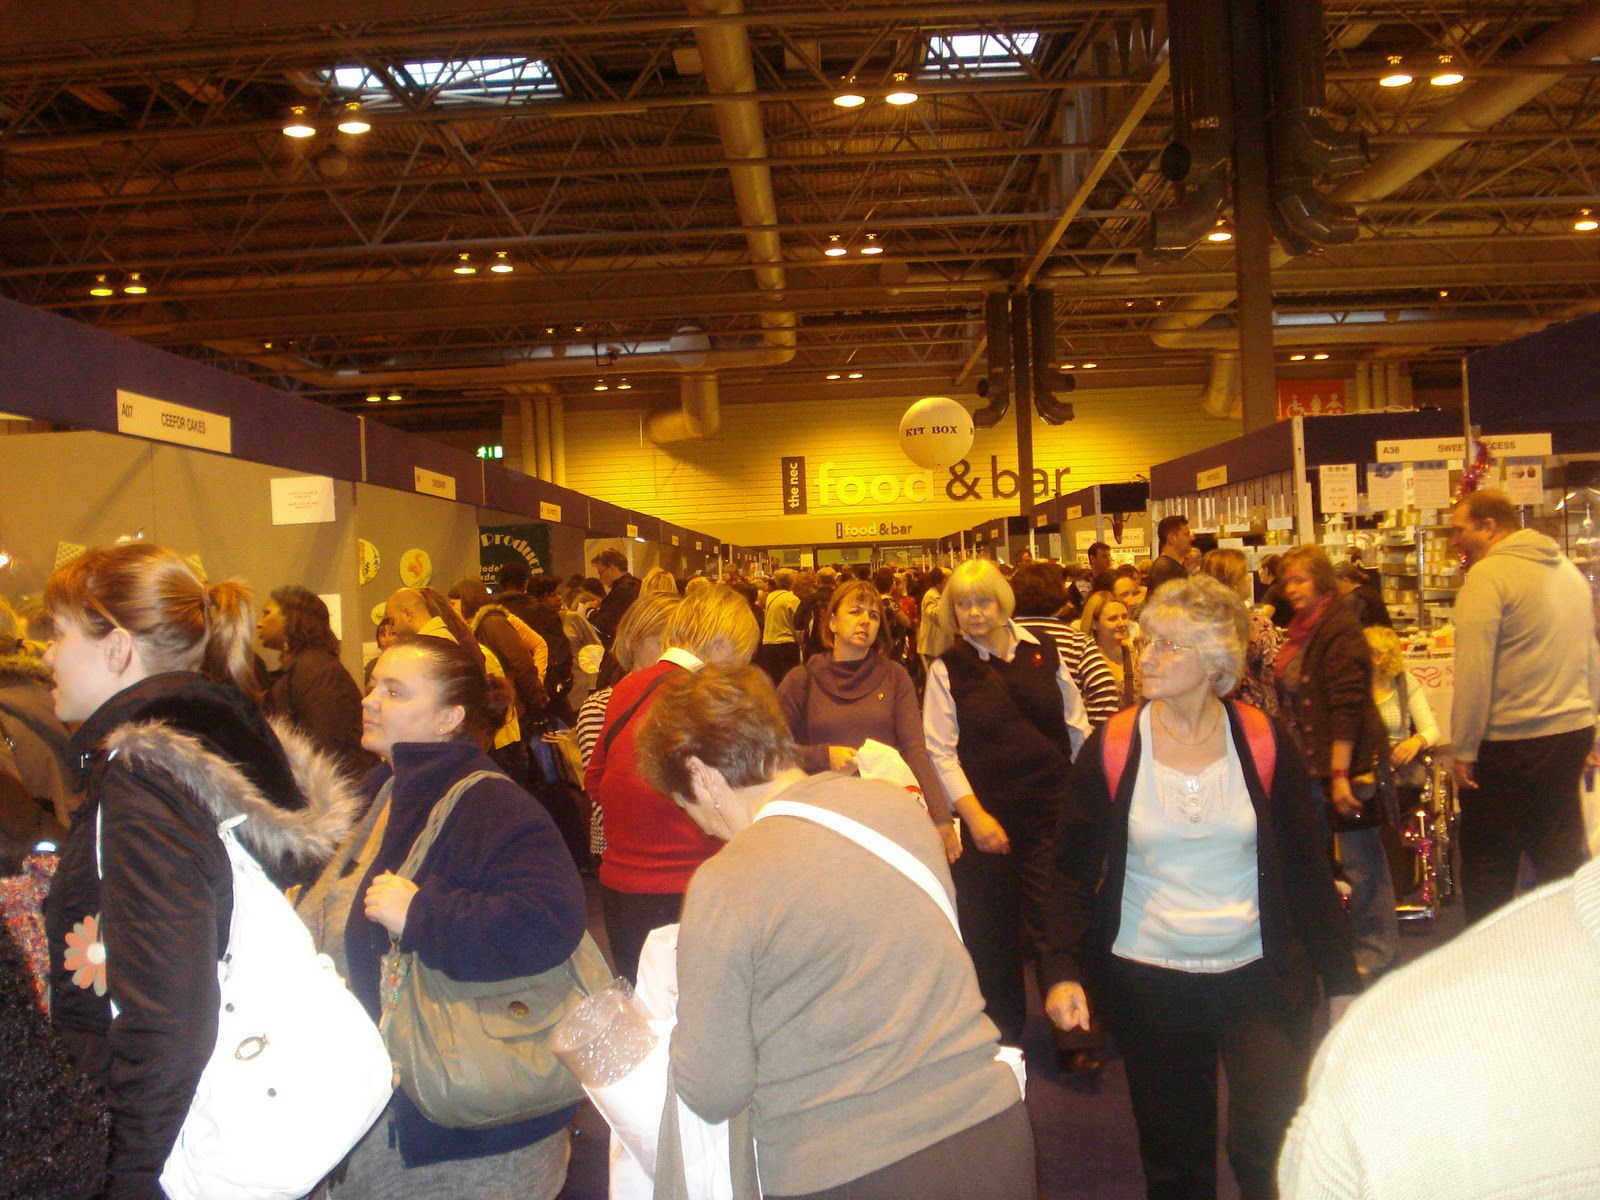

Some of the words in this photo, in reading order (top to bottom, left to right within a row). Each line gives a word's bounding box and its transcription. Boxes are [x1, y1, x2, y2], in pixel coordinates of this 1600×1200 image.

[121, 403, 134, 418] A07
[161, 413, 186, 430] CEEFOR
[186, 418, 206, 435] CAKES
[905, 426, 926, 438] KIT
[931, 425, 958, 435] BOX
[1383, 446, 1400, 454] A38
[1438, 443, 1466, 453] SWEE
[789, 462, 799, 485] nec
[814, 461, 935, 506] food
[946, 459, 983, 501] &
[991, 455, 1071, 499] bar
[787, 486, 800, 509] the
[844, 522, 877, 537] food
[879, 523, 889, 536] &
[891, 522, 913, 535] bar
